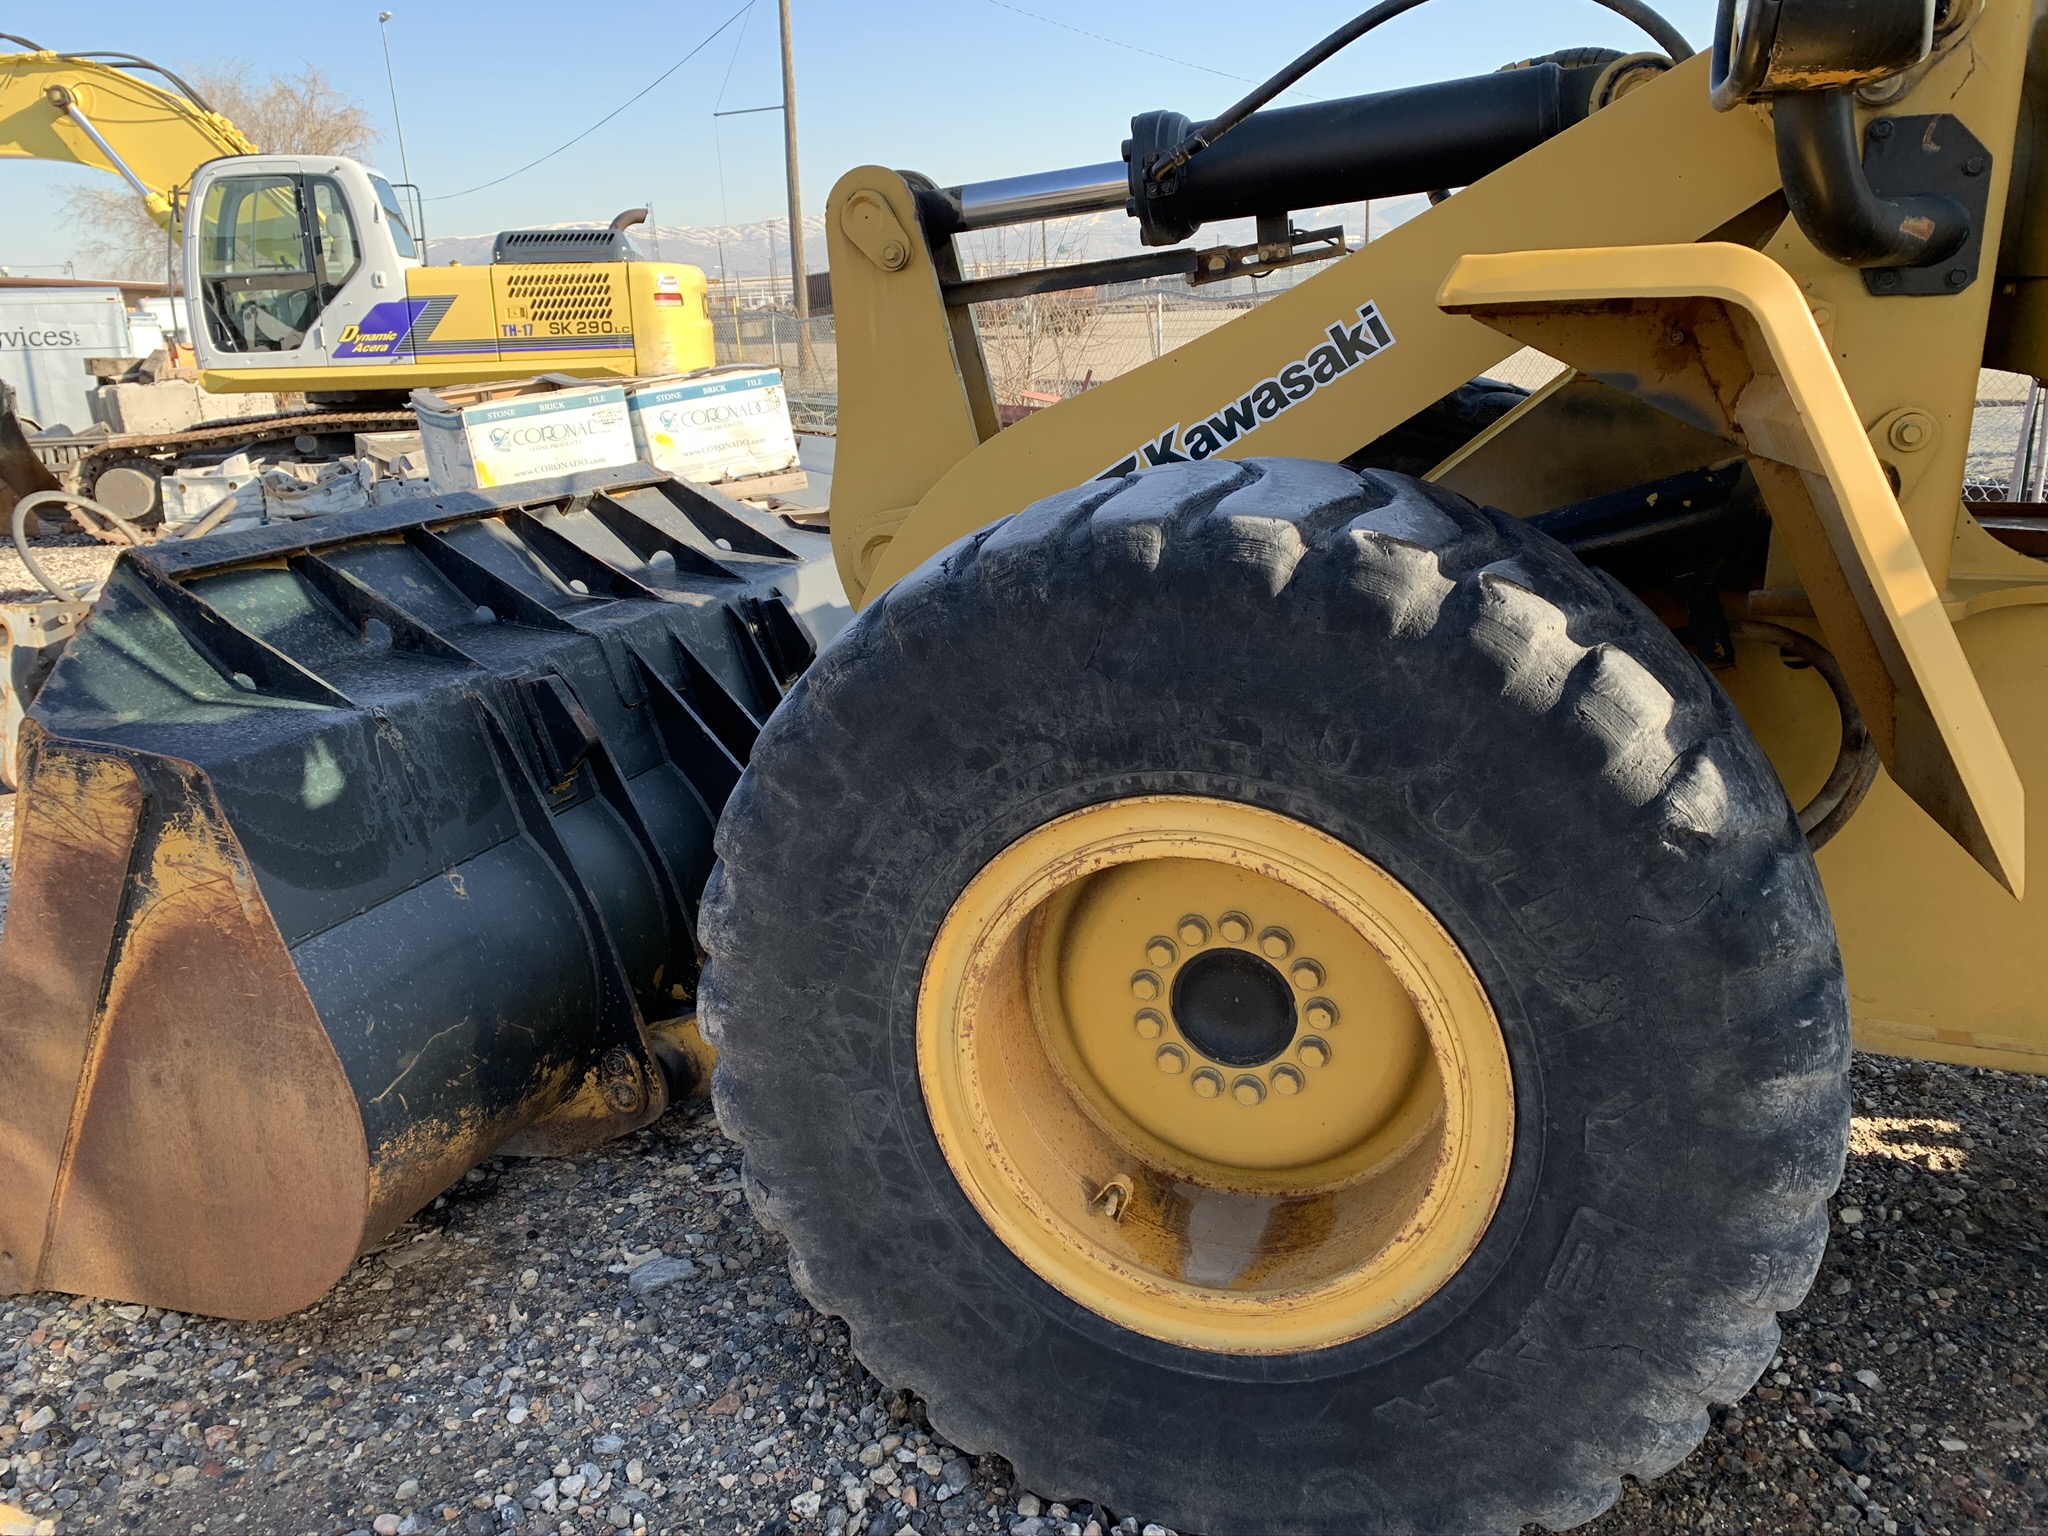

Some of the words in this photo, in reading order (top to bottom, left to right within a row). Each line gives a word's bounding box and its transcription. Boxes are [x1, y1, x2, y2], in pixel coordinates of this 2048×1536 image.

[0, 326, 73, 347] vices
[337, 324, 398, 345] Dynamic
[501, 323, 533, 337] TH-17
[549, 321, 572, 335] SK
[576, 320, 613, 334] 290
[351, 343, 389, 353] Acera
[655, 391, 683, 402] STONE
[702, 384, 727, 394] BRICK
[745, 378, 764, 387] TILE
[1140, 300, 1394, 468] Kawasaki
[487, 408, 516, 420] STONE
[538, 401, 566, 412] BRICK
[586, 394, 607, 404] TILE
[680, 399, 770, 427] CORONADO
[513, 418, 611, 446] CORONAD
[682, 438, 766, 457] www.CORONADO.com
[513, 457, 606, 478] www.CORONADO.com
